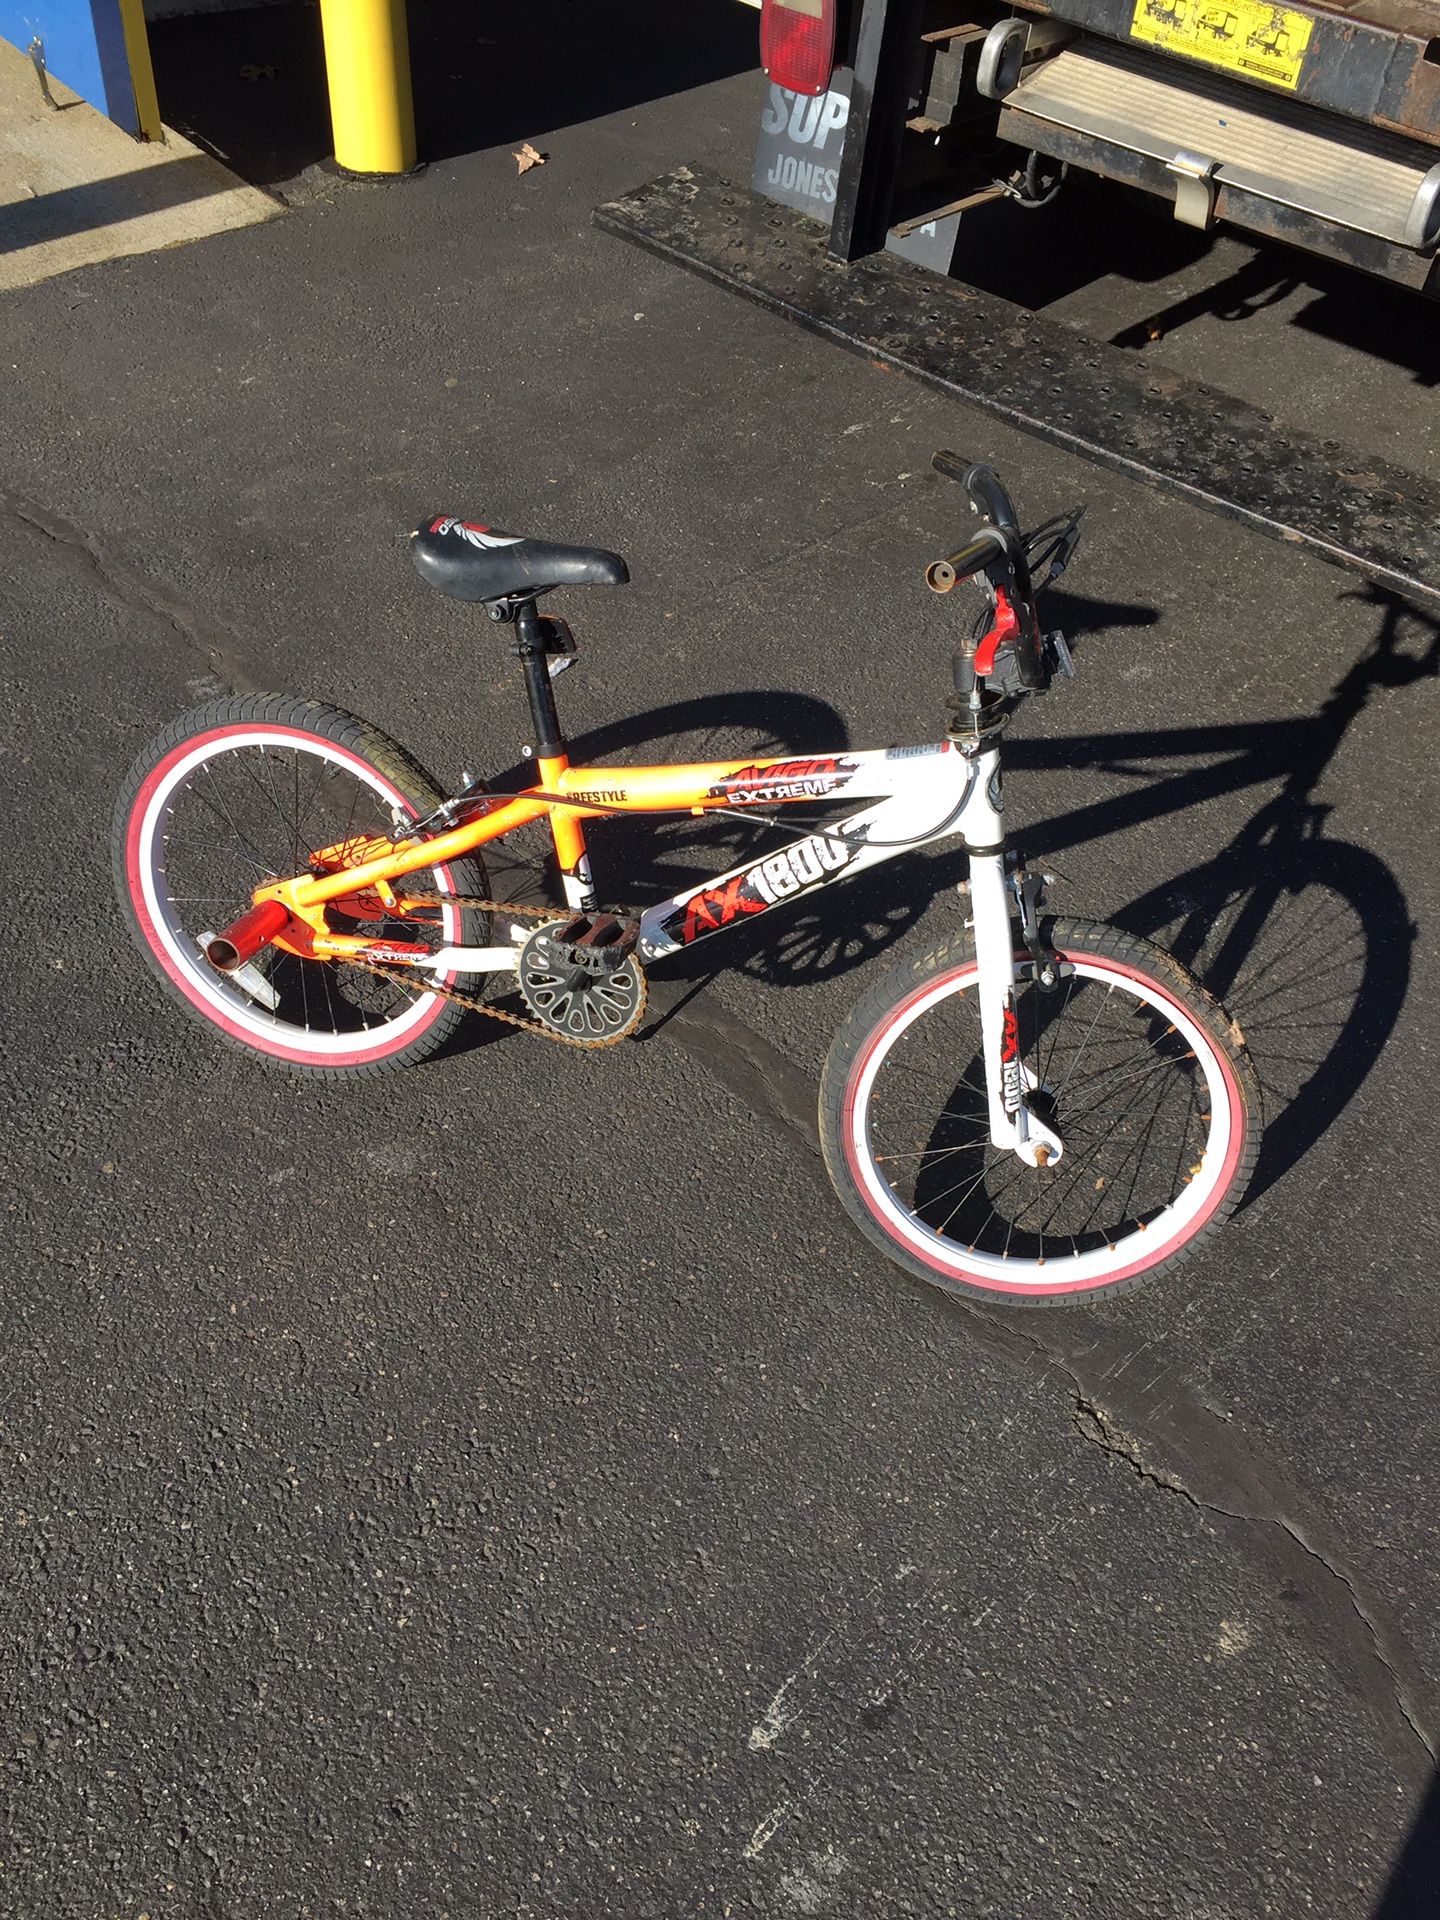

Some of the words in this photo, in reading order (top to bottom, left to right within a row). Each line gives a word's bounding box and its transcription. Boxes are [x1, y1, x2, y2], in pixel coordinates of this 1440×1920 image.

[727, 758, 837, 793] AVIGO
[566, 790, 628, 803] FREESTYLE
[682, 875, 769, 944] AX
[745, 835, 849, 905] 1800
